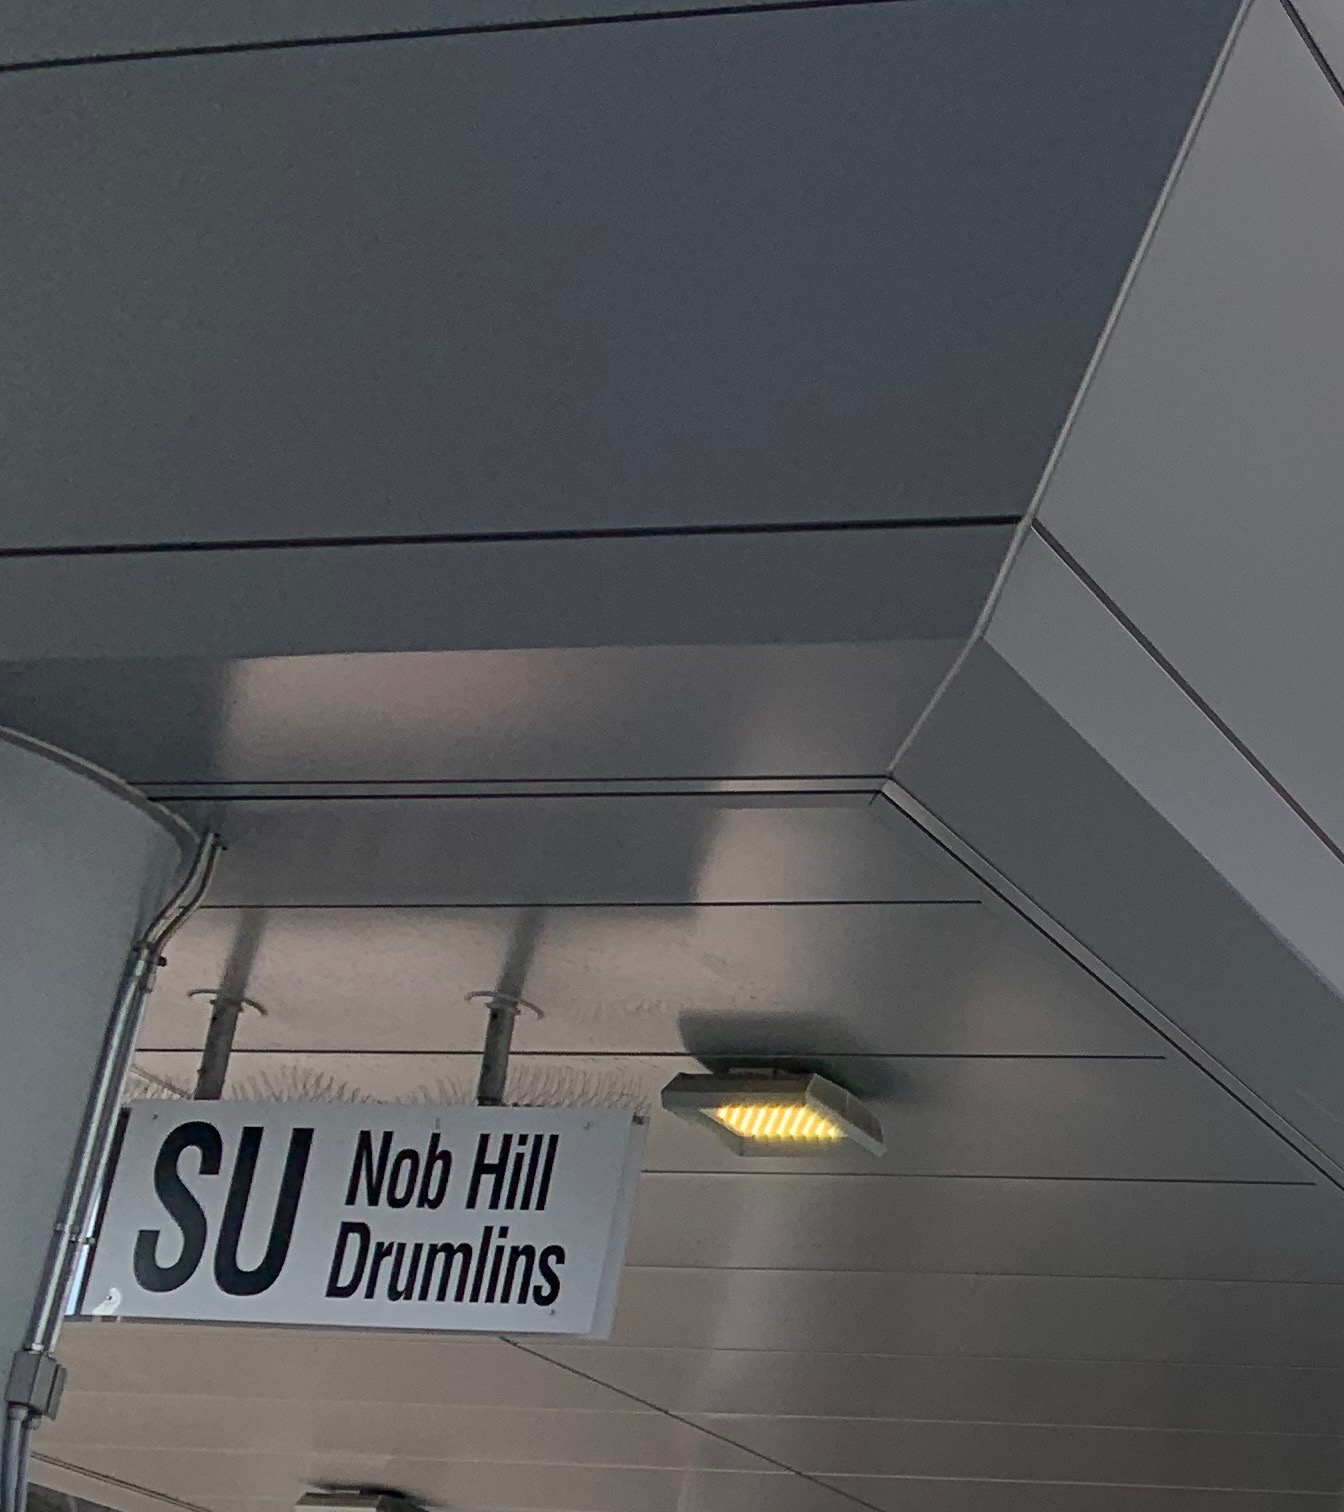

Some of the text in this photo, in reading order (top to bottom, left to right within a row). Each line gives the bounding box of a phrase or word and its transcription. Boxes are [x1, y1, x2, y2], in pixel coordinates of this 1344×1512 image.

[133, 1120, 315, 1297] SU
[344, 1129, 560, 1212] Nob Hill
[324, 1221, 567, 1308] Drumlins
